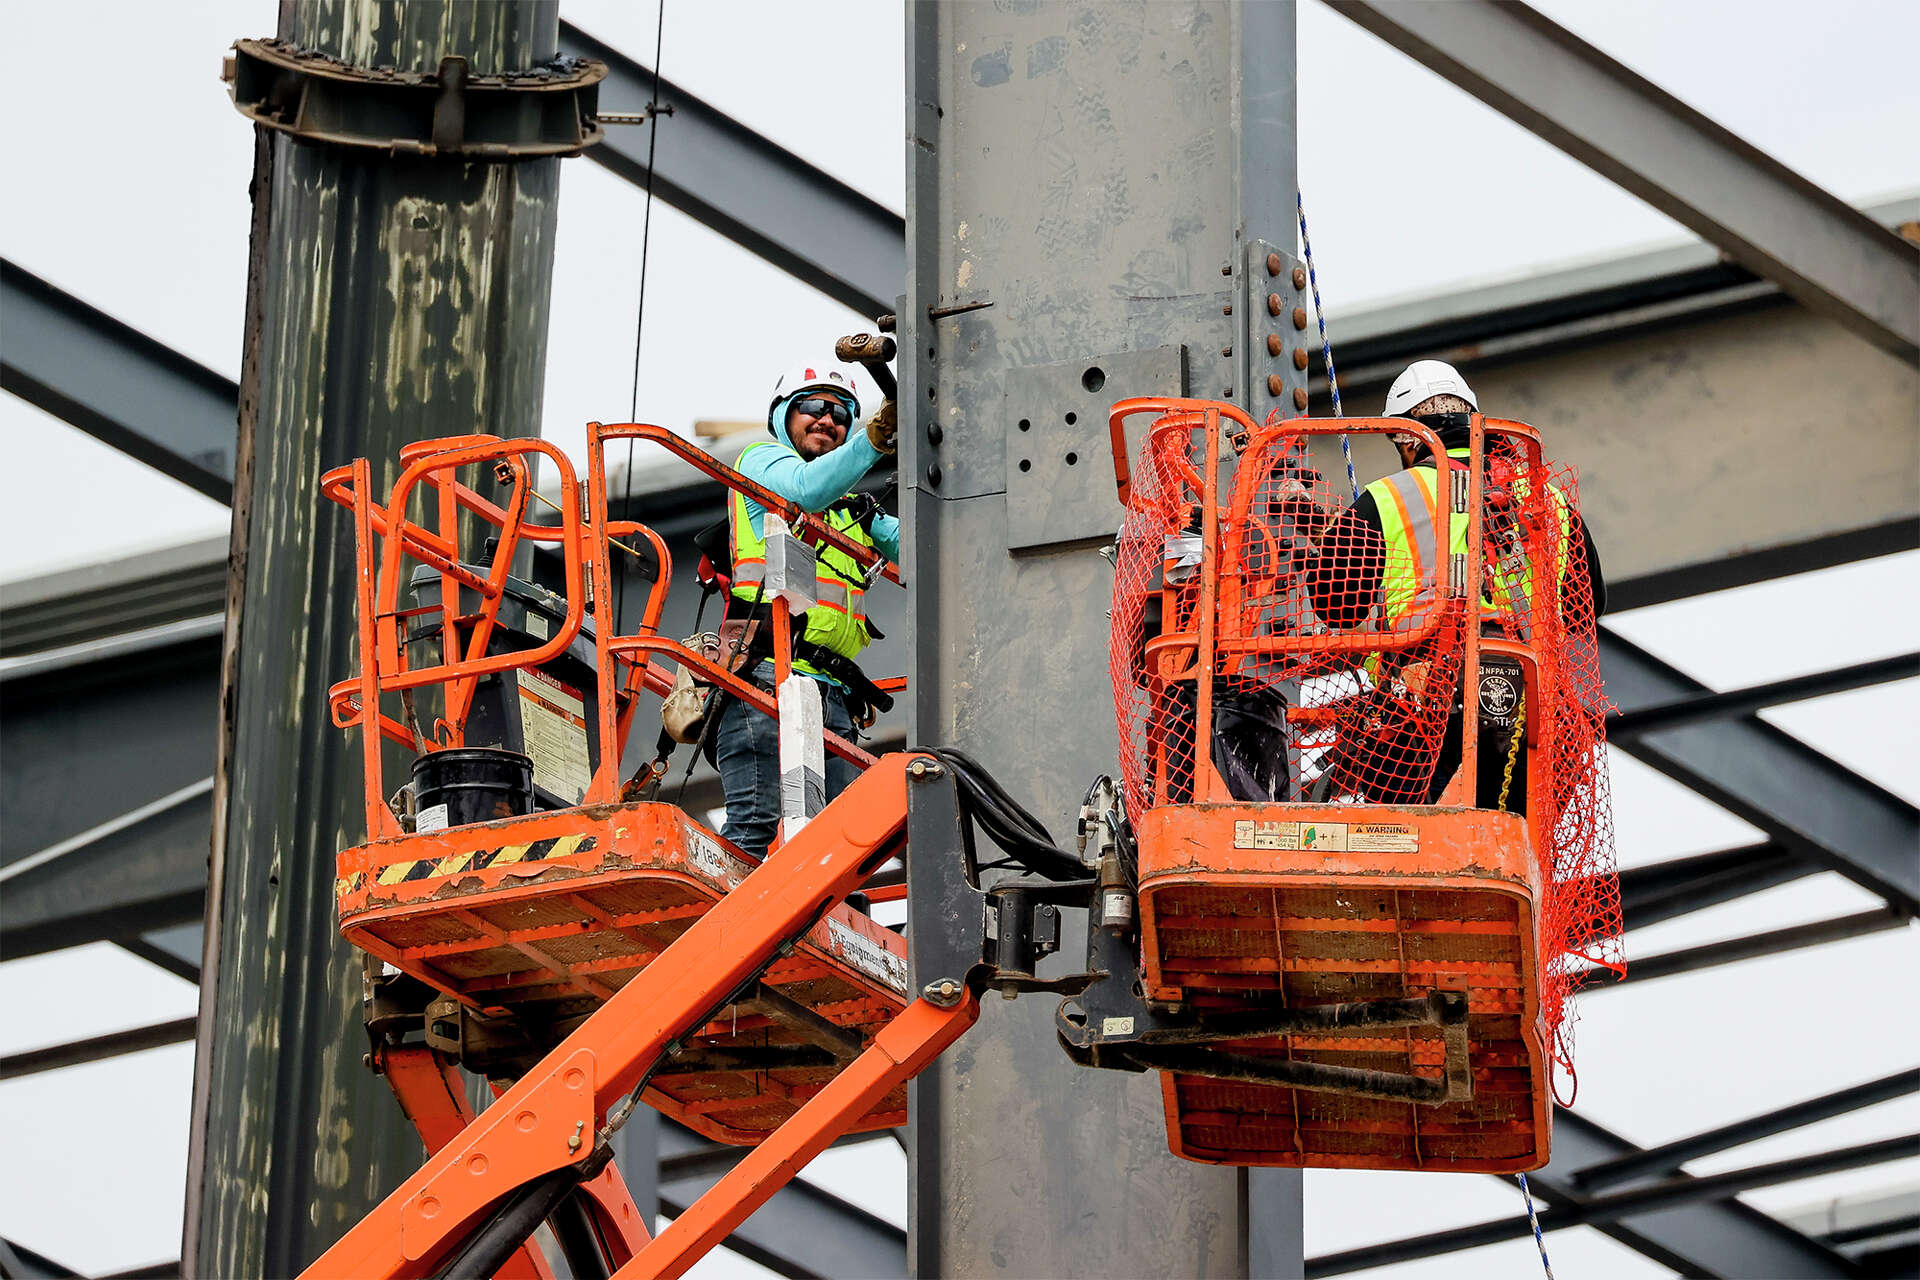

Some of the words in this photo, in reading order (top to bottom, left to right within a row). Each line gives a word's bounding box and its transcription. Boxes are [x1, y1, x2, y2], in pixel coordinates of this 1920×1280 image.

[1485, 667, 1519, 676] NFPA-701
[540, 672, 562, 690] DANGER
[1366, 826, 1409, 834] WARNING
